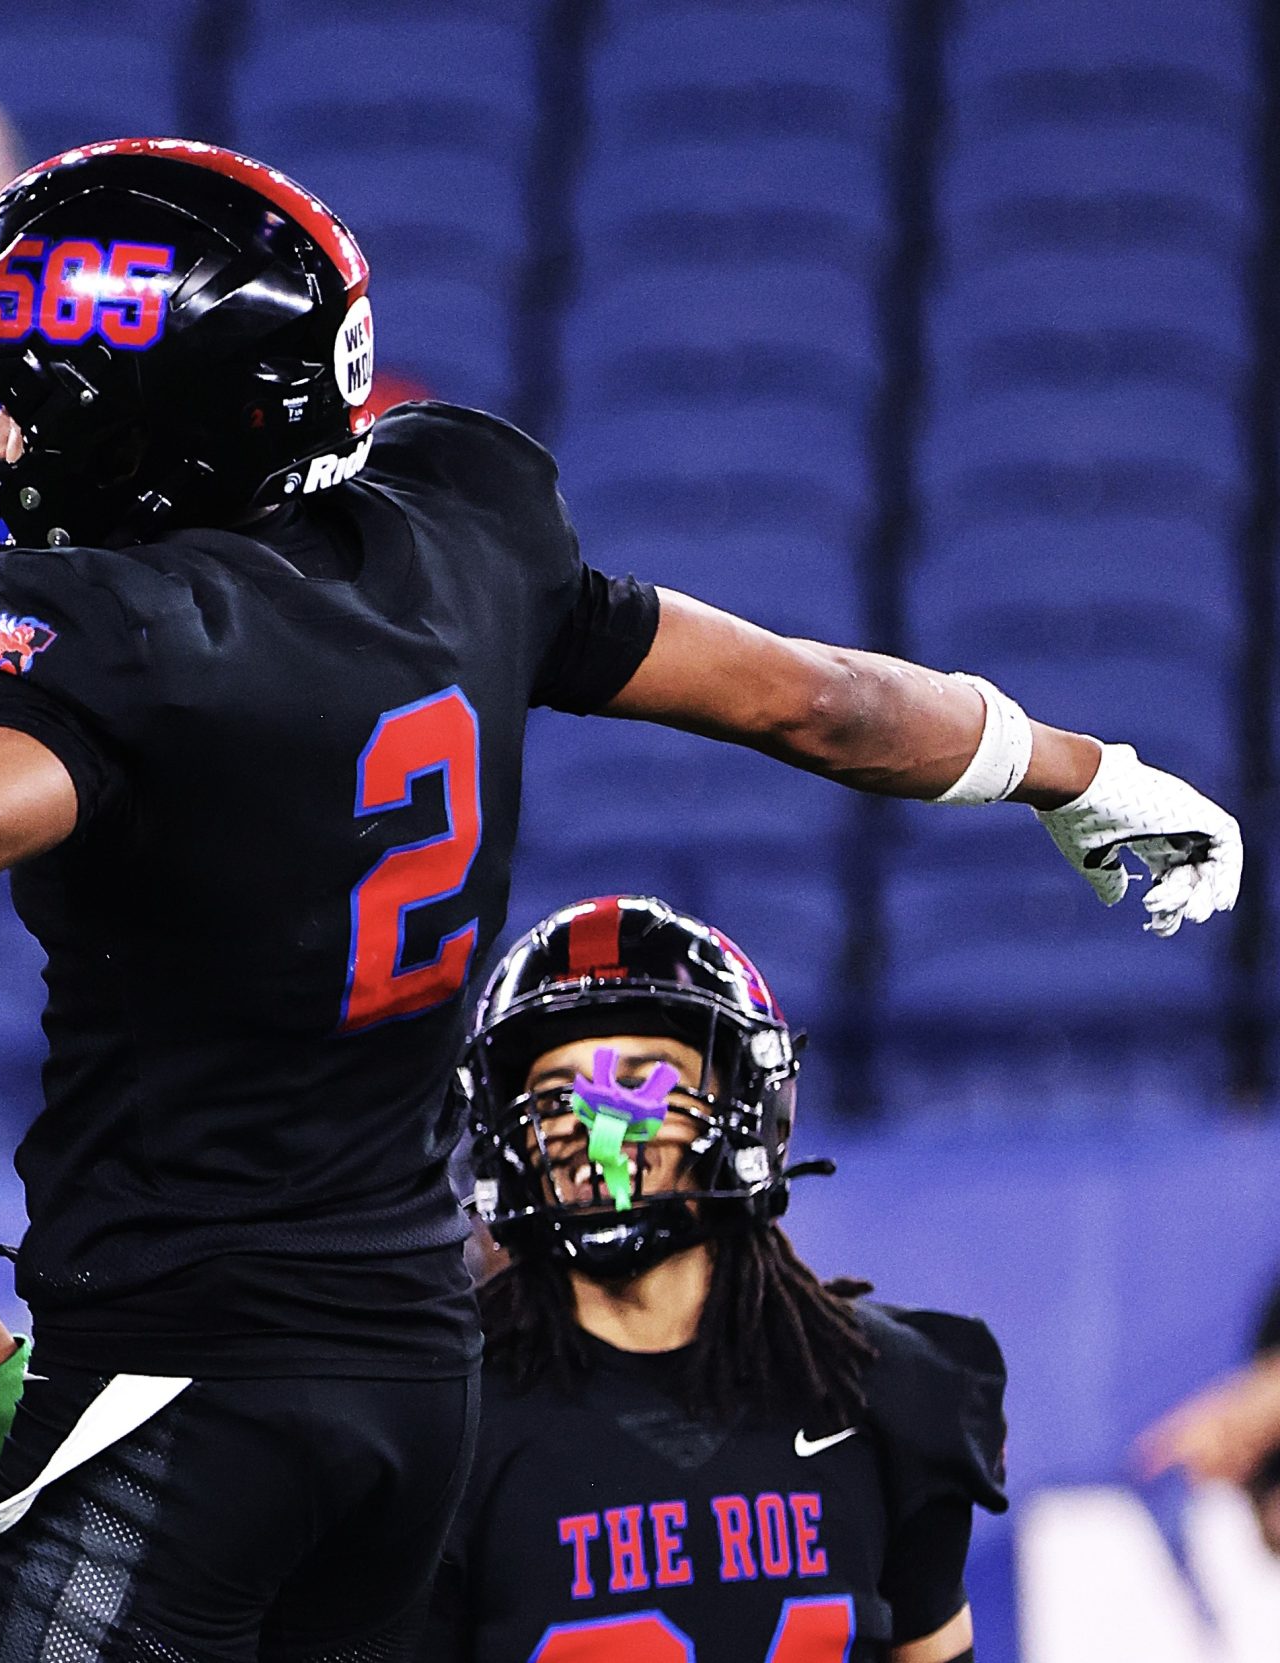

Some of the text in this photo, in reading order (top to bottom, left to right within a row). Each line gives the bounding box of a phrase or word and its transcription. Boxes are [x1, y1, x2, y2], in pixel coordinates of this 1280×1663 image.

[345, 322, 364, 353] WE
[340, 683, 483, 1038] 2
[558, 1491, 829, 1599] THE ROE
